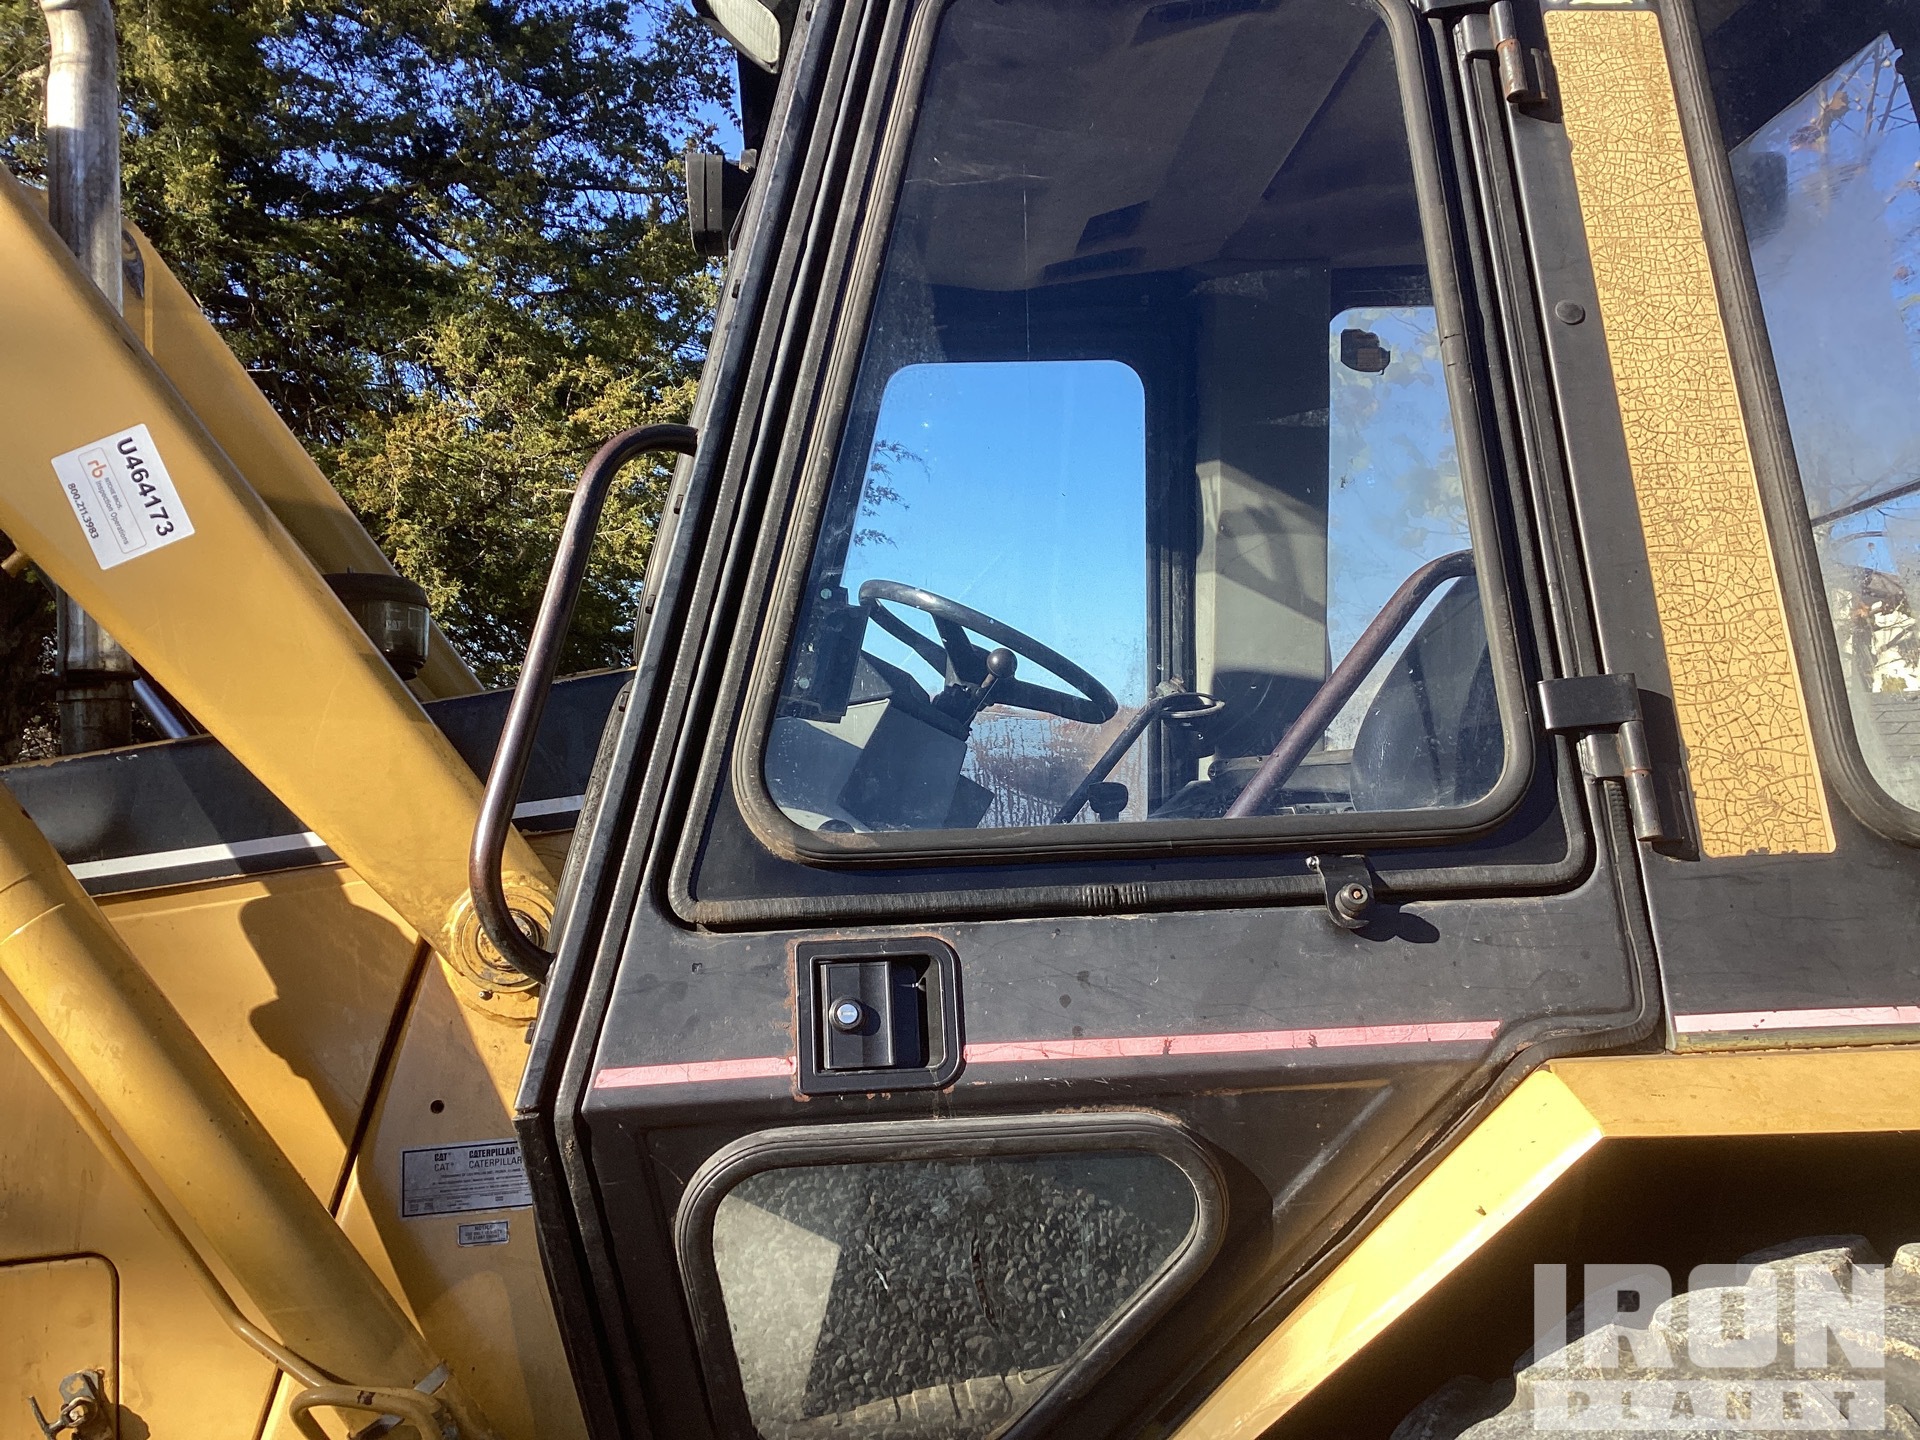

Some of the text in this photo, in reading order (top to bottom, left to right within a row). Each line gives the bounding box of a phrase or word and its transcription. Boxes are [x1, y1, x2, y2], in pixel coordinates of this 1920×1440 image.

[67, 482, 100, 539] 800.211.3983
[95, 481, 129, 545] Inspection Operations
[116, 436, 175, 537] U464173
[434, 1147, 516, 1162] CAT CATERPILLAR
[434, 1156, 523, 1172] CAT CATERPILLAR
